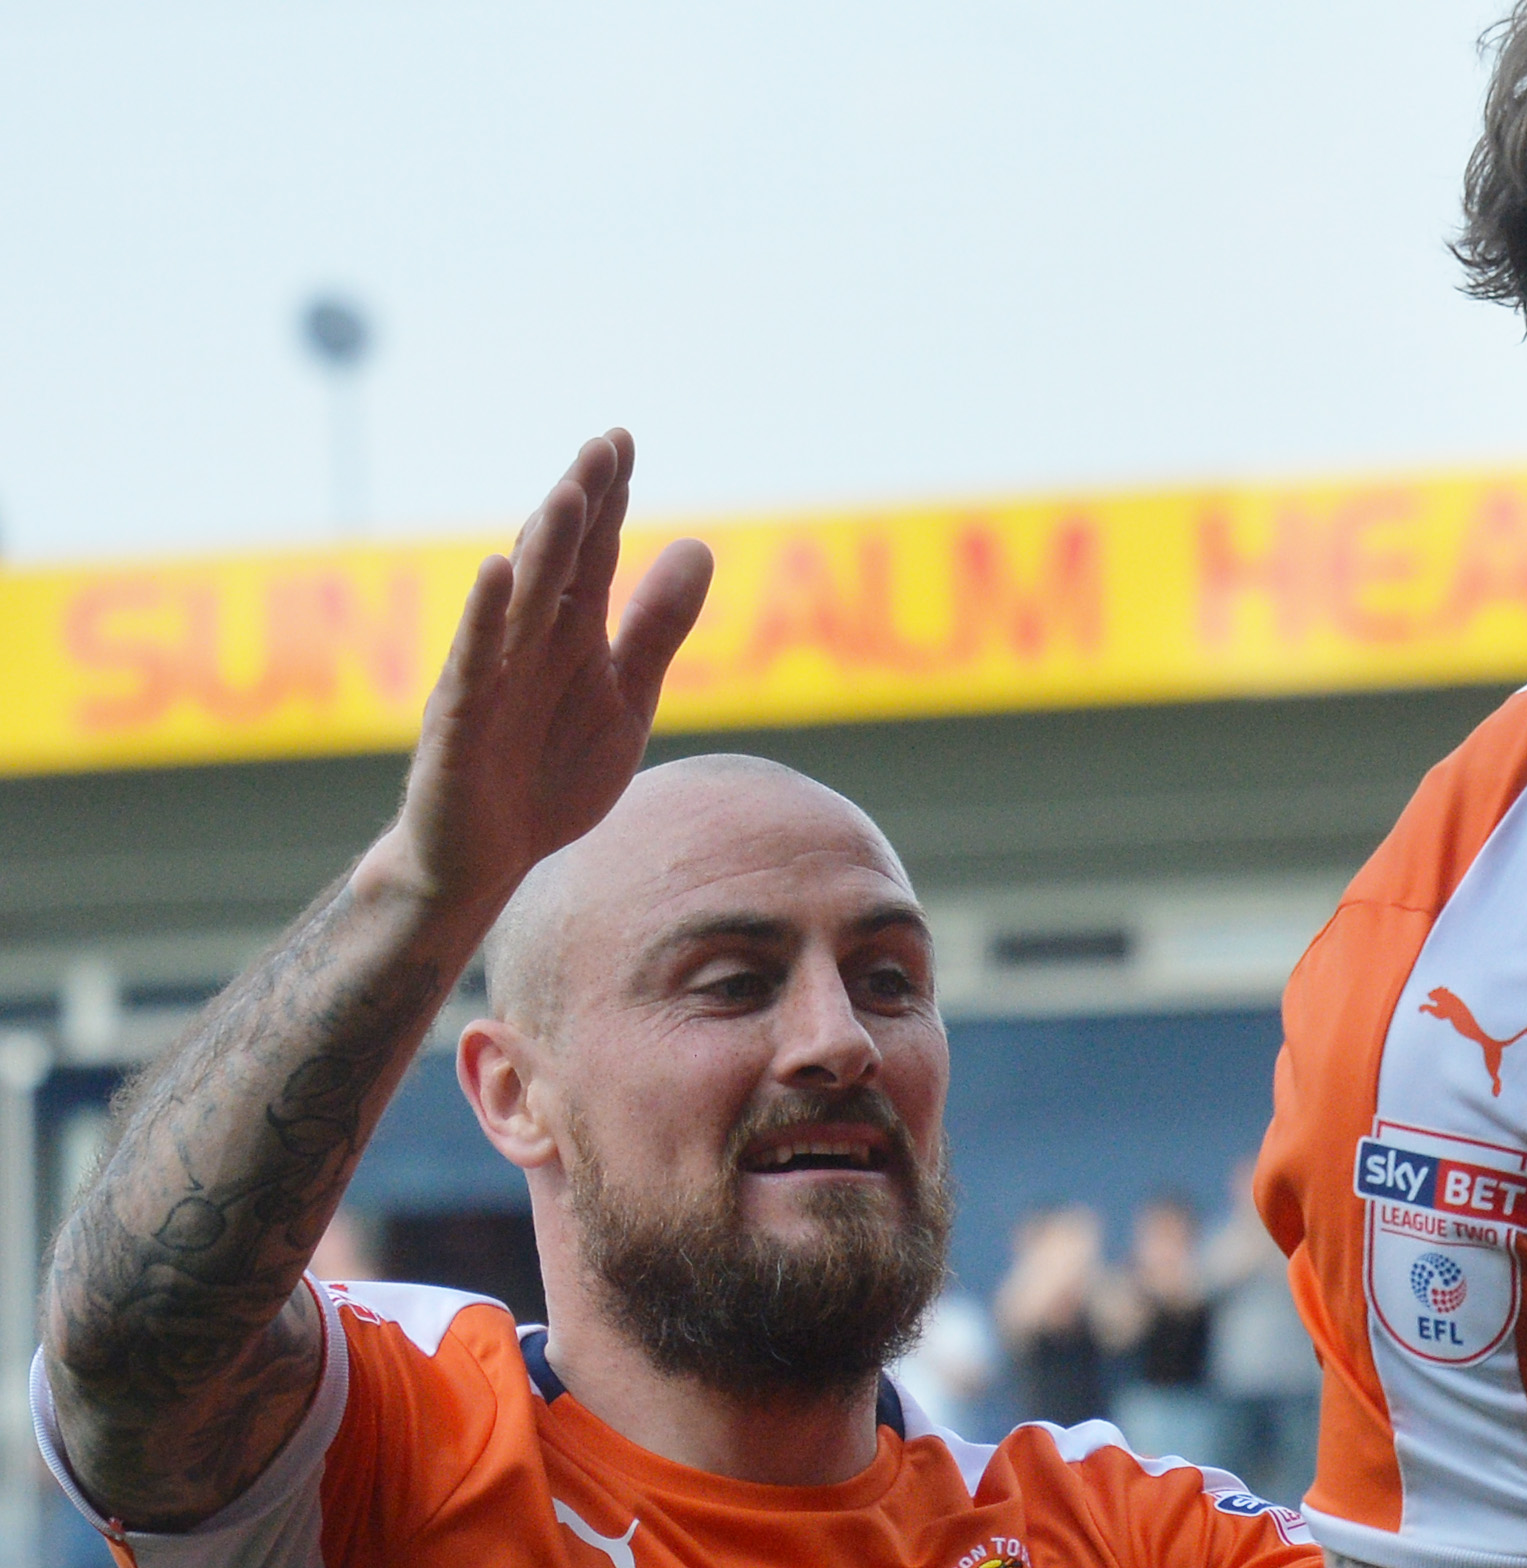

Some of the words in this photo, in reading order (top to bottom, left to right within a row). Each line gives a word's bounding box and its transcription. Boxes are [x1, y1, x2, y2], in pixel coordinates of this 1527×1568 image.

[62, 562, 425, 735] SUN
[1444, 1169, 1527, 1216] BET
[1381, 1205, 1447, 1238] LEAGUE
[1453, 1221, 1498, 1246] TWO
[1418, 1316, 1464, 1346] EFL
